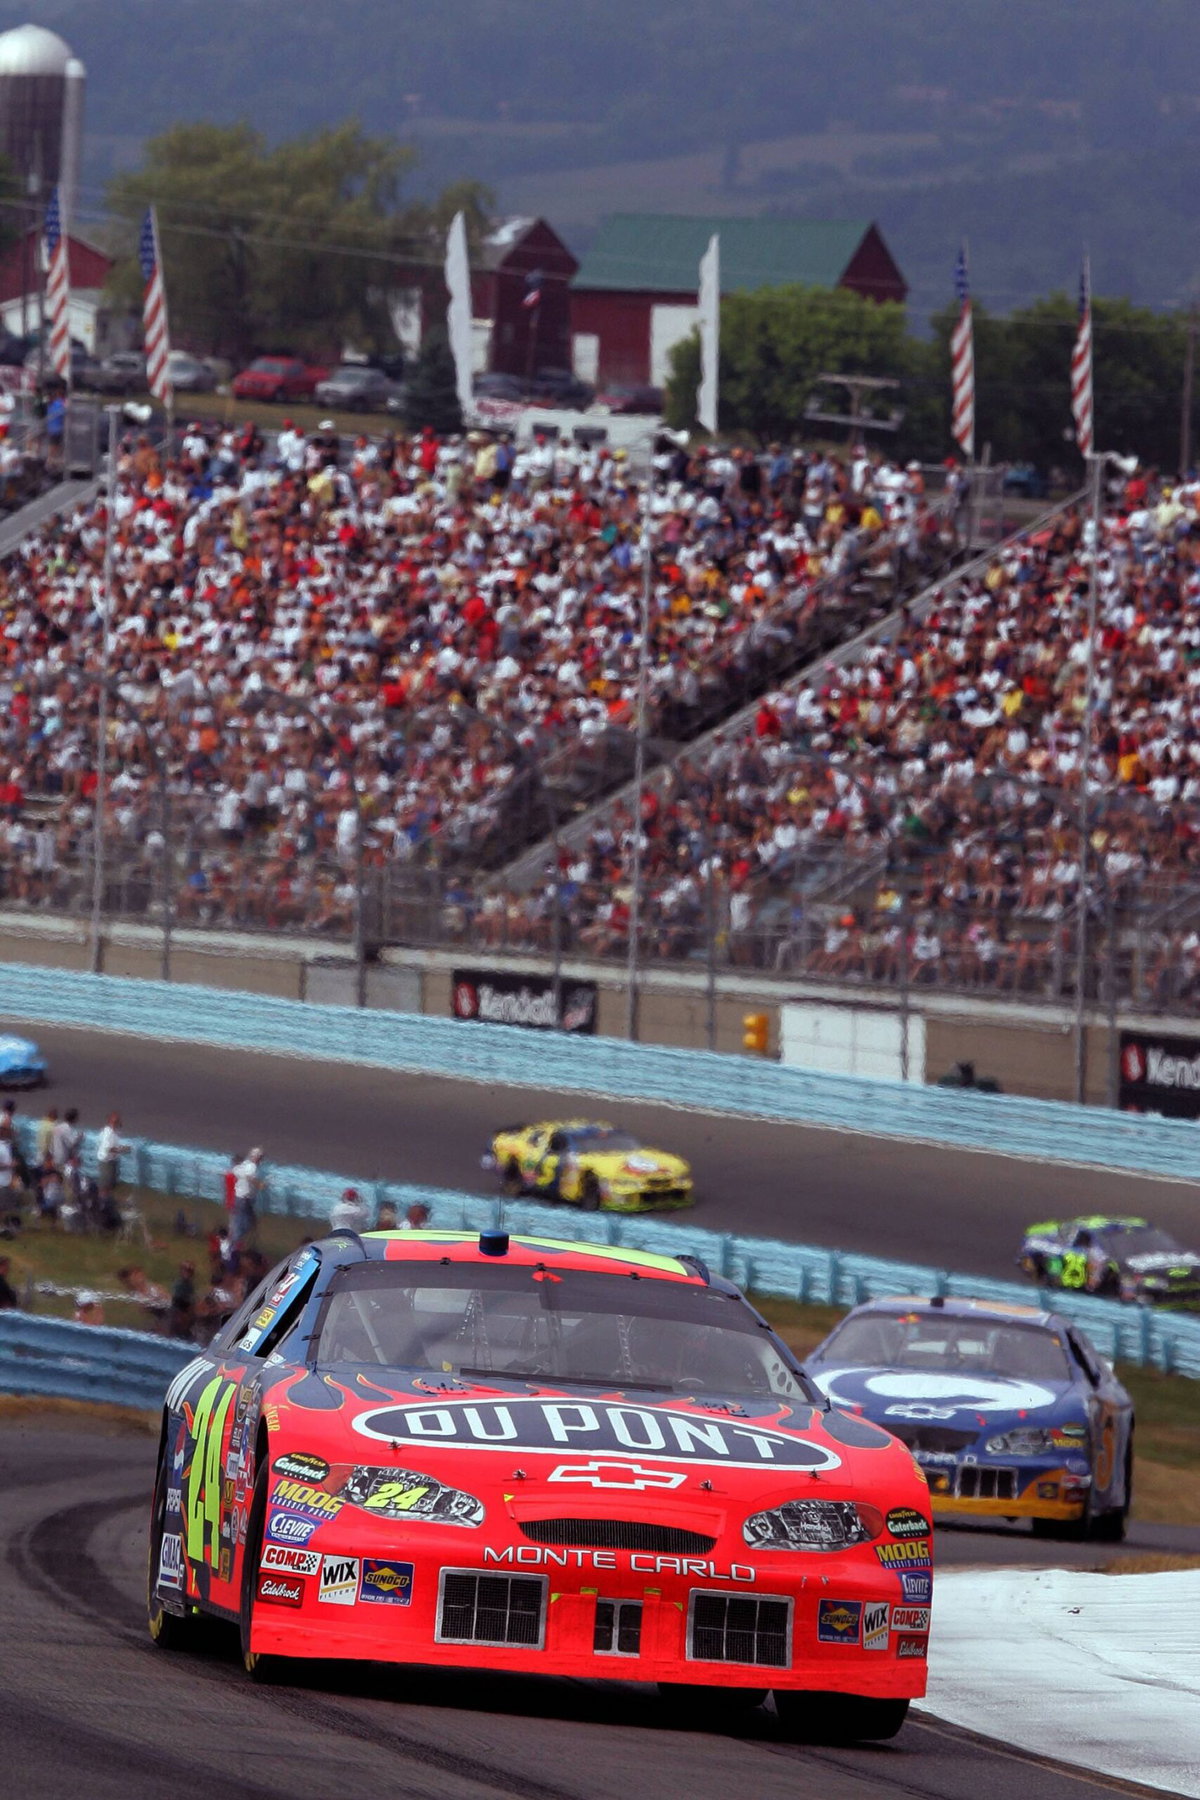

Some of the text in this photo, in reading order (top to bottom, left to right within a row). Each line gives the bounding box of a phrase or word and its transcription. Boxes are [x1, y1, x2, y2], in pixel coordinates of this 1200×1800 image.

[403, 1403, 785, 1458] DU PONT
[275, 1457, 326, 1480] Gatorback
[273, 1480, 346, 1514] MOOG
[364, 1482, 431, 1511] 24
[887, 1519, 928, 1533] Gatorback
[265, 1547, 307, 1566] COMP
[876, 1541, 929, 1562] MOOG
[323, 1560, 357, 1586] WIX
[484, 1546, 757, 1583] MONTE CARLO
[366, 1573, 408, 1586] SUNOCO
[261, 1580, 301, 1601] Edelbrock
[320, 1587, 356, 1600] FILTERS
[822, 1614, 858, 1625] SUNOCO
[864, 1604, 889, 1633] WIX
[893, 1610, 920, 1625] COMP
